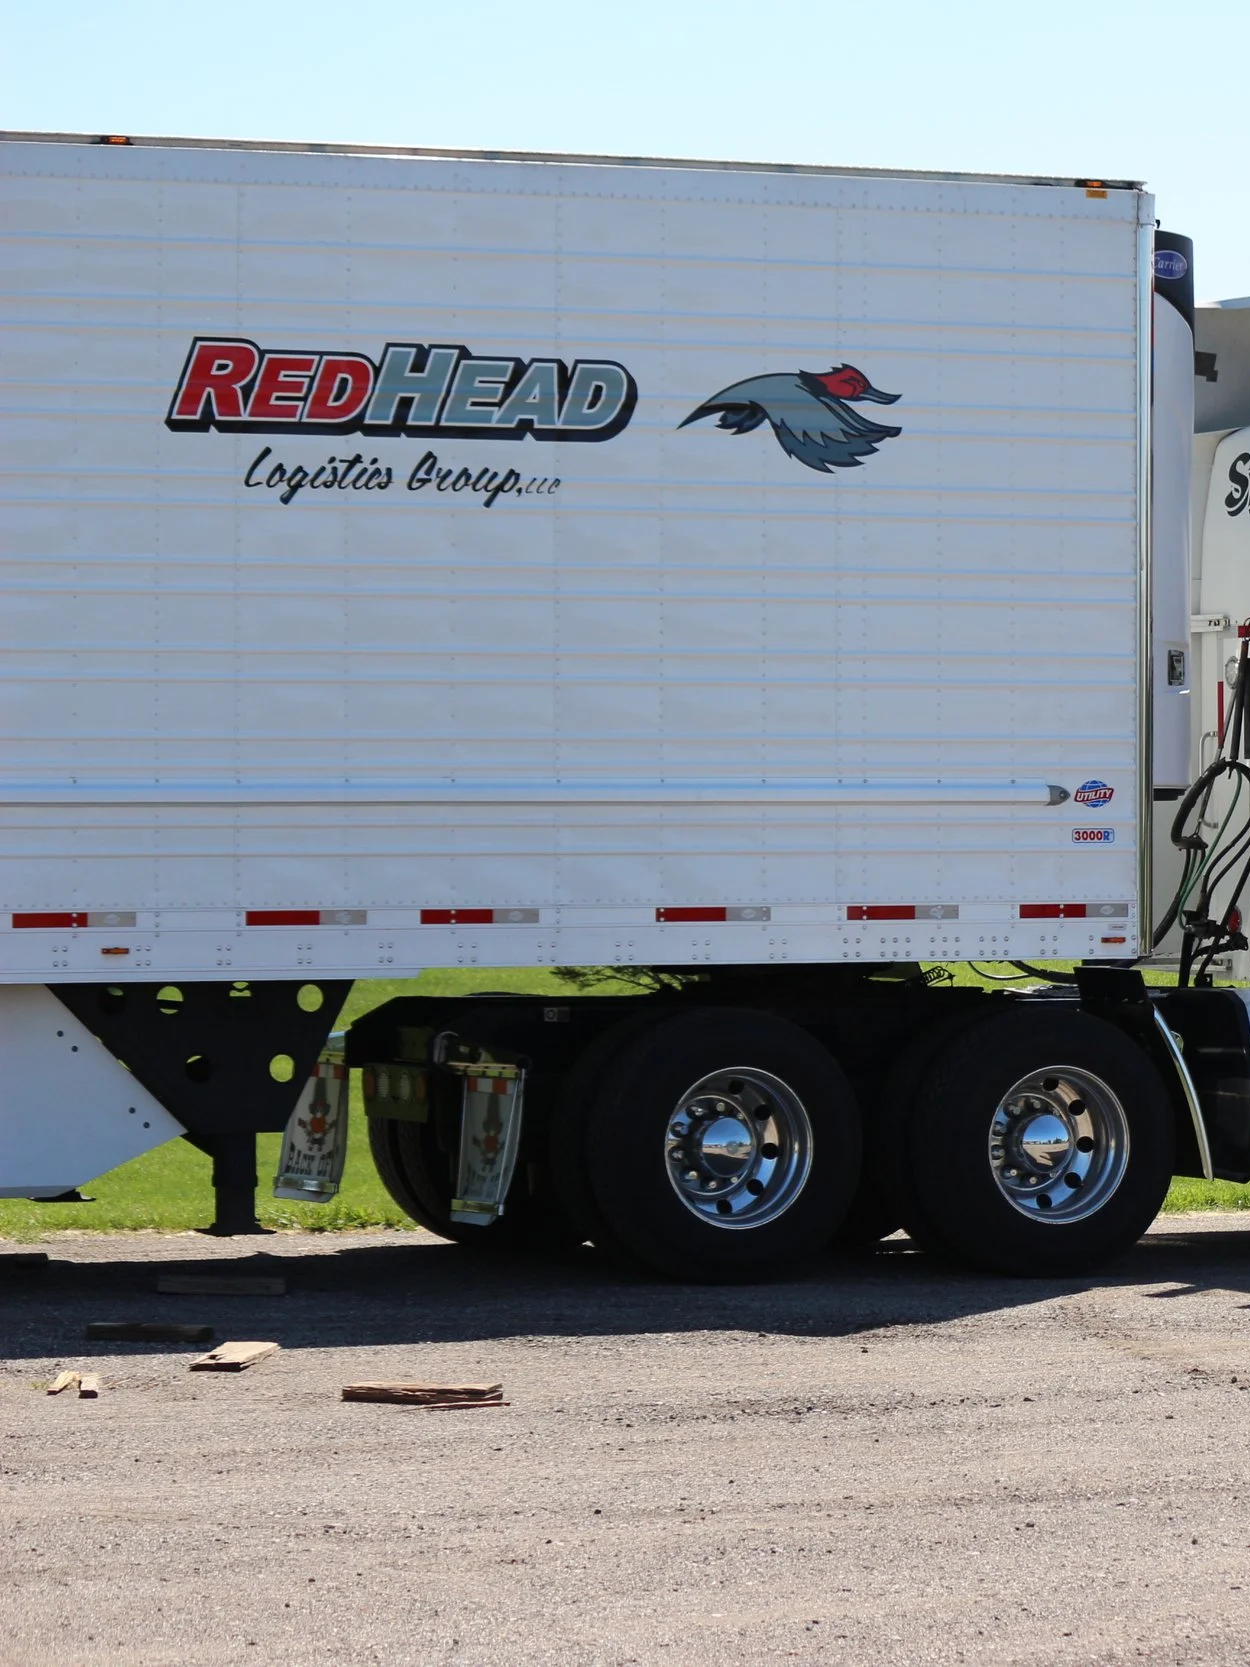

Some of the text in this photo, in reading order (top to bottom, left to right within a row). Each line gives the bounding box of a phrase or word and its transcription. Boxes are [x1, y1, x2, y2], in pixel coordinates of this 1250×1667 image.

[243, 446, 393, 505] Logistics
[1076, 789, 1112, 801] UTILITY
[1074, 830, 1110, 841] 3000R
